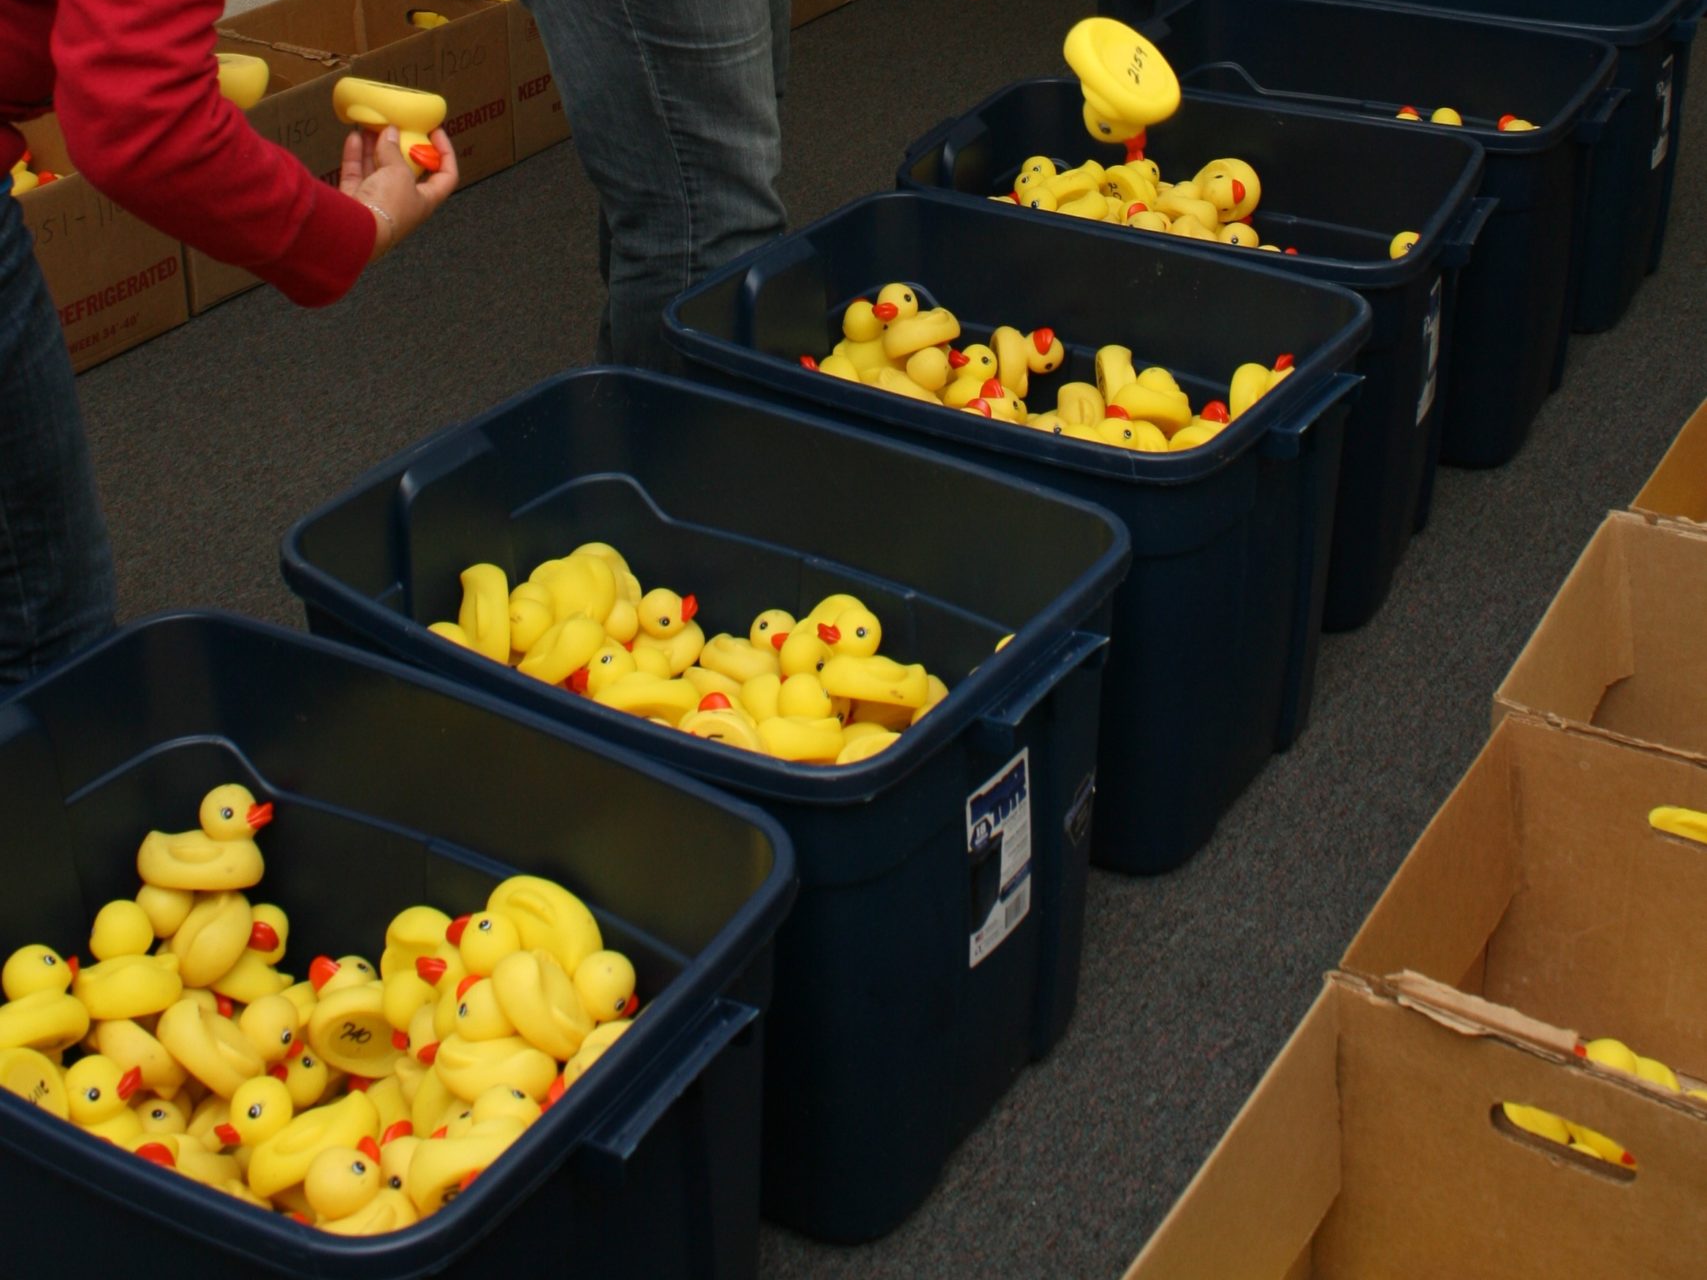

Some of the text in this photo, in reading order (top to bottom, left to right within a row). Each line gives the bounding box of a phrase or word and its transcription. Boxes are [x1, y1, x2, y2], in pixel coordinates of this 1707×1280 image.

[1127, 46, 1147, 85] 2159
[517, 73, 552, 102] KEEP
[441, 98, 507, 138] GERATED
